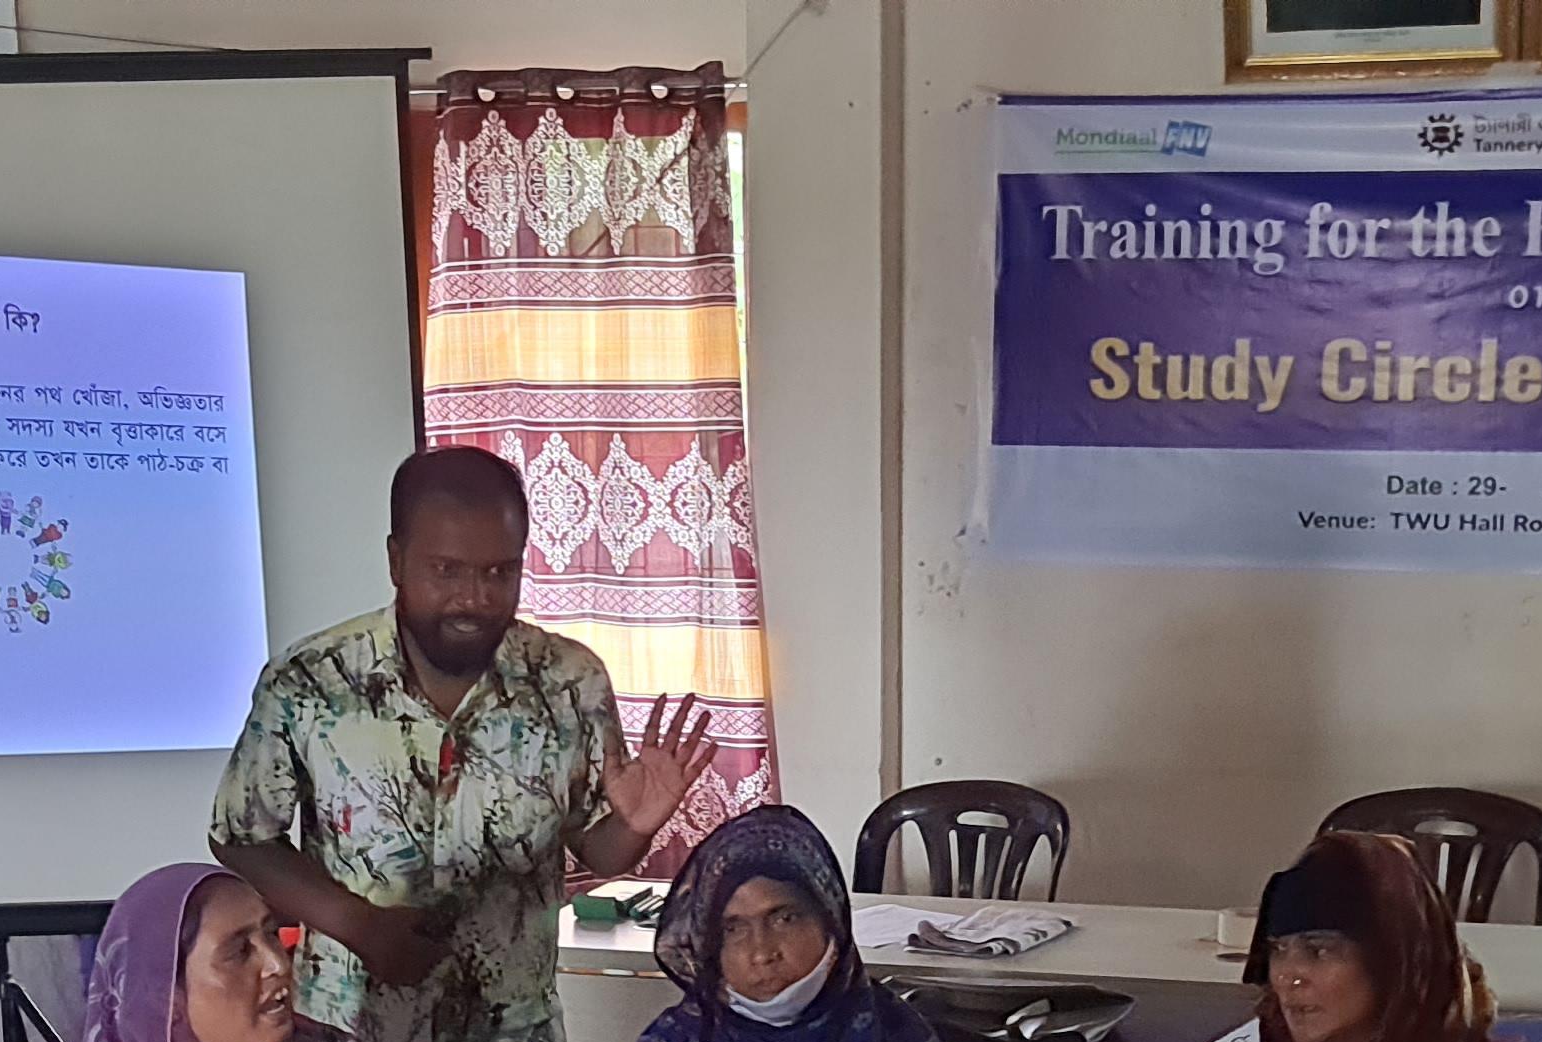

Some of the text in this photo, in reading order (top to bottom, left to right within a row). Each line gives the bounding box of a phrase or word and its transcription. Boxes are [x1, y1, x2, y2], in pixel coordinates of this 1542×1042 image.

[1055, 122, 1212, 153] Mondiaal FNV
[1473, 138, 1542, 154] Tannery
[1042, 203, 1285, 275] Training
[1304, 201, 1392, 260] for
[1410, 199, 1503, 258] the
[3, 302, 41, 334] কি?
[1089, 336, 1294, 412] Study
[34, 385, 63, 406] পথ
[137, 385, 226, 413] অভিজ্ঞতার
[5, 417, 55, 438] সদস্য
[62, 419, 103, 439] যখন
[109, 422, 187, 448] বৃত্তাকারে
[192, 425, 229, 445] বসে
[33, 450, 78, 470] তখন
[83, 452, 131, 471] তাকে
[137, 448, 204, 474] পাঠ-চক্র
[211, 455, 230, 475] বা
[1386, 474, 1444, 496] Date
[1468, 475, 1508, 497] 29-
[1297, 510, 1376, 530] Venue:
[1389, 511, 1452, 532] TWU
[1459, 512, 1505, 533] Hall
